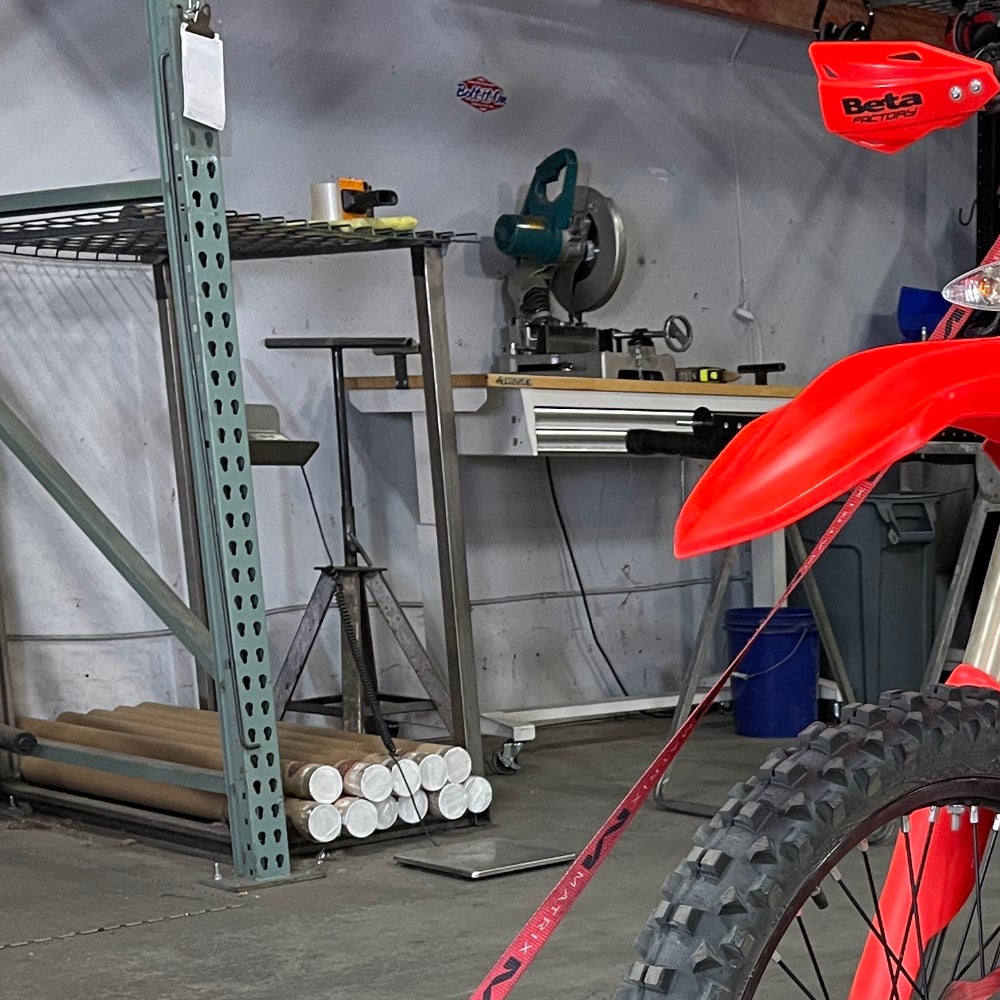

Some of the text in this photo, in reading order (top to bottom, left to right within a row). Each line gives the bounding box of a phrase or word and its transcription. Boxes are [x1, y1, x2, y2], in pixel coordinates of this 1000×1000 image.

[842, 92, 923, 115] Beta
[853, 107, 918, 124] FACTORY
[519, 872, 584, 954] MATRIX
